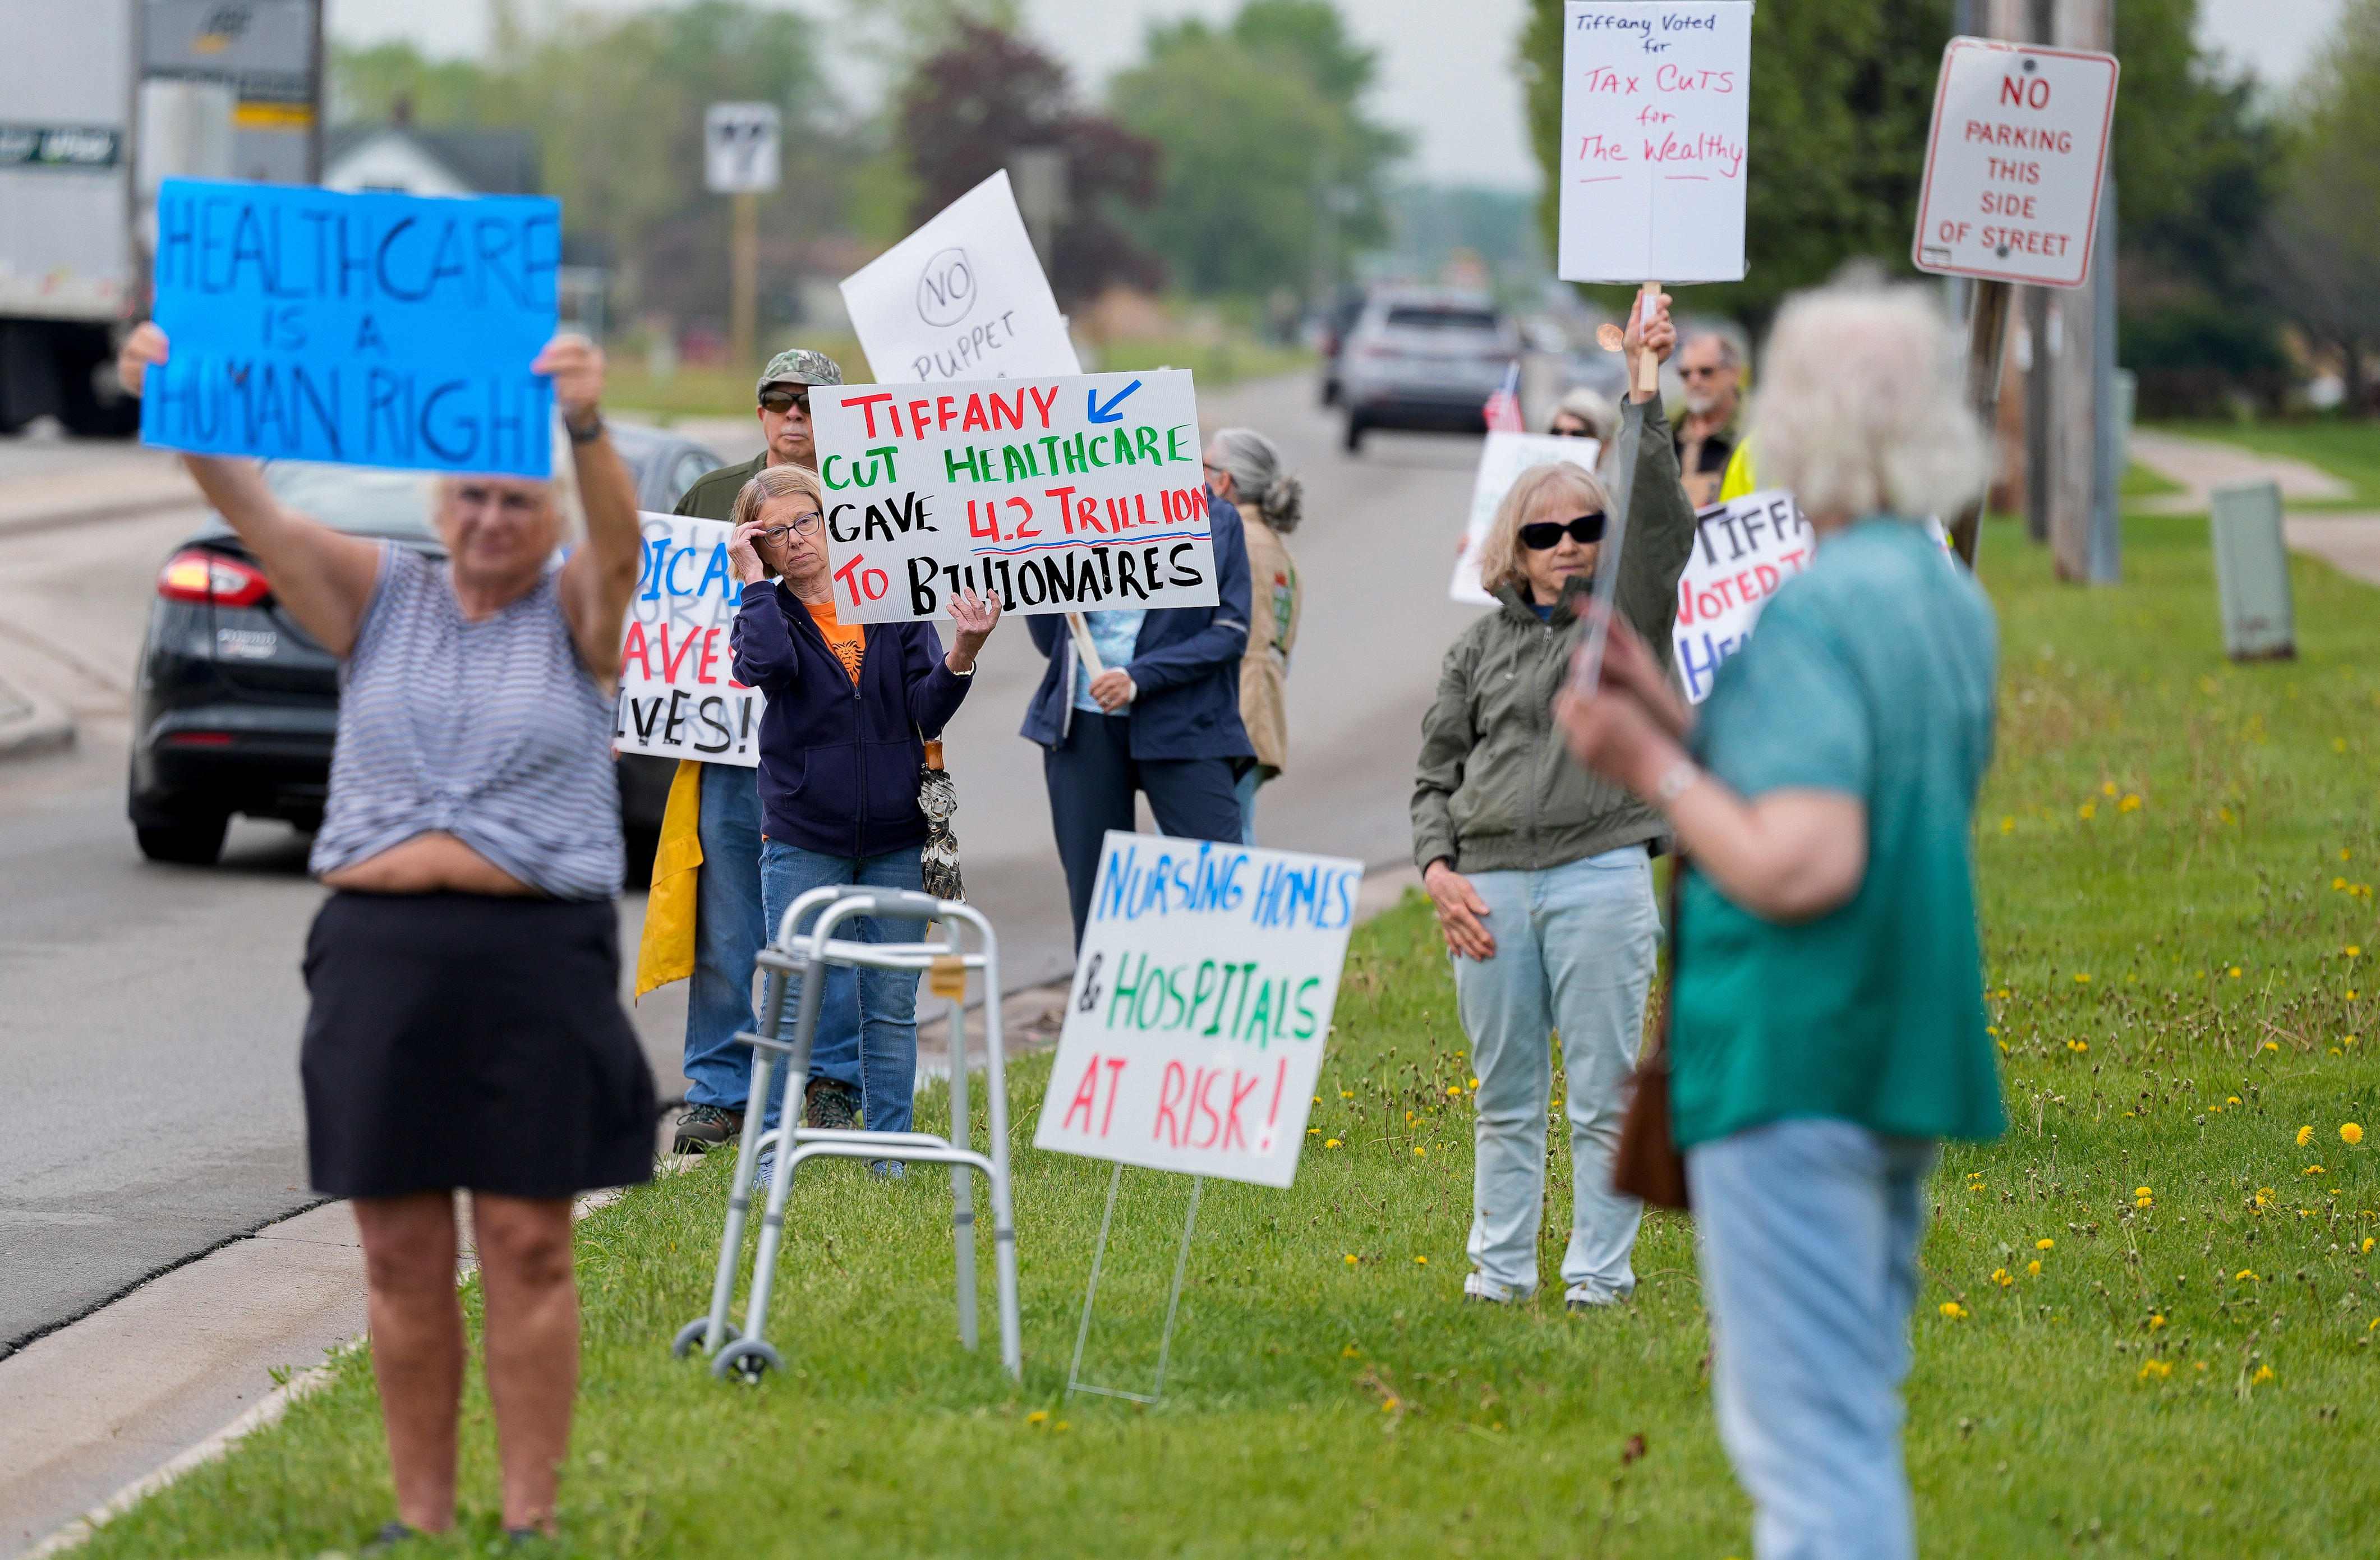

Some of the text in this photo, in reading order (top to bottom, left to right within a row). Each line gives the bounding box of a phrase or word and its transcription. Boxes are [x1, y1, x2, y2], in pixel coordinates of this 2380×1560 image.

[1577, 13, 1716, 39] Tiffany Voted
[1642, 38, 1672, 54] for
[1636, 103, 1675, 126] for
[2000, 74, 2051, 110] NO
[1579, 131, 1743, 178] The Wealthy
[1965, 119, 2073, 154] PARKING
[1988, 156, 2040, 185] THIS
[1980, 190, 2037, 219] SIDE
[164, 194, 560, 314] HEALTHCARE
[1939, 219, 1972, 244] OF
[1981, 225, 2071, 257] STREET
[925, 261, 970, 312] NO
[261, 304, 388, 357] IS A
[911, 310, 1014, 381] PUPPET
[155, 357, 555, 470] HUMAN RIGHT
[841, 385, 1059, 440] TIFFANY
[822, 424, 1193, 490] CUT HEALTHCARE
[828, 482, 1209, 544] GAVE 4.2 TRILLION
[834, 542, 1203, 616] TO BILLIONAIRES
[1678, 563, 1780, 627] VOTED
[1097, 840, 1360, 930] NURSING HOMES
[1078, 950, 1320, 1051] & HOSPITALS
[1062, 1052, 1288, 1152] AT RISK!
